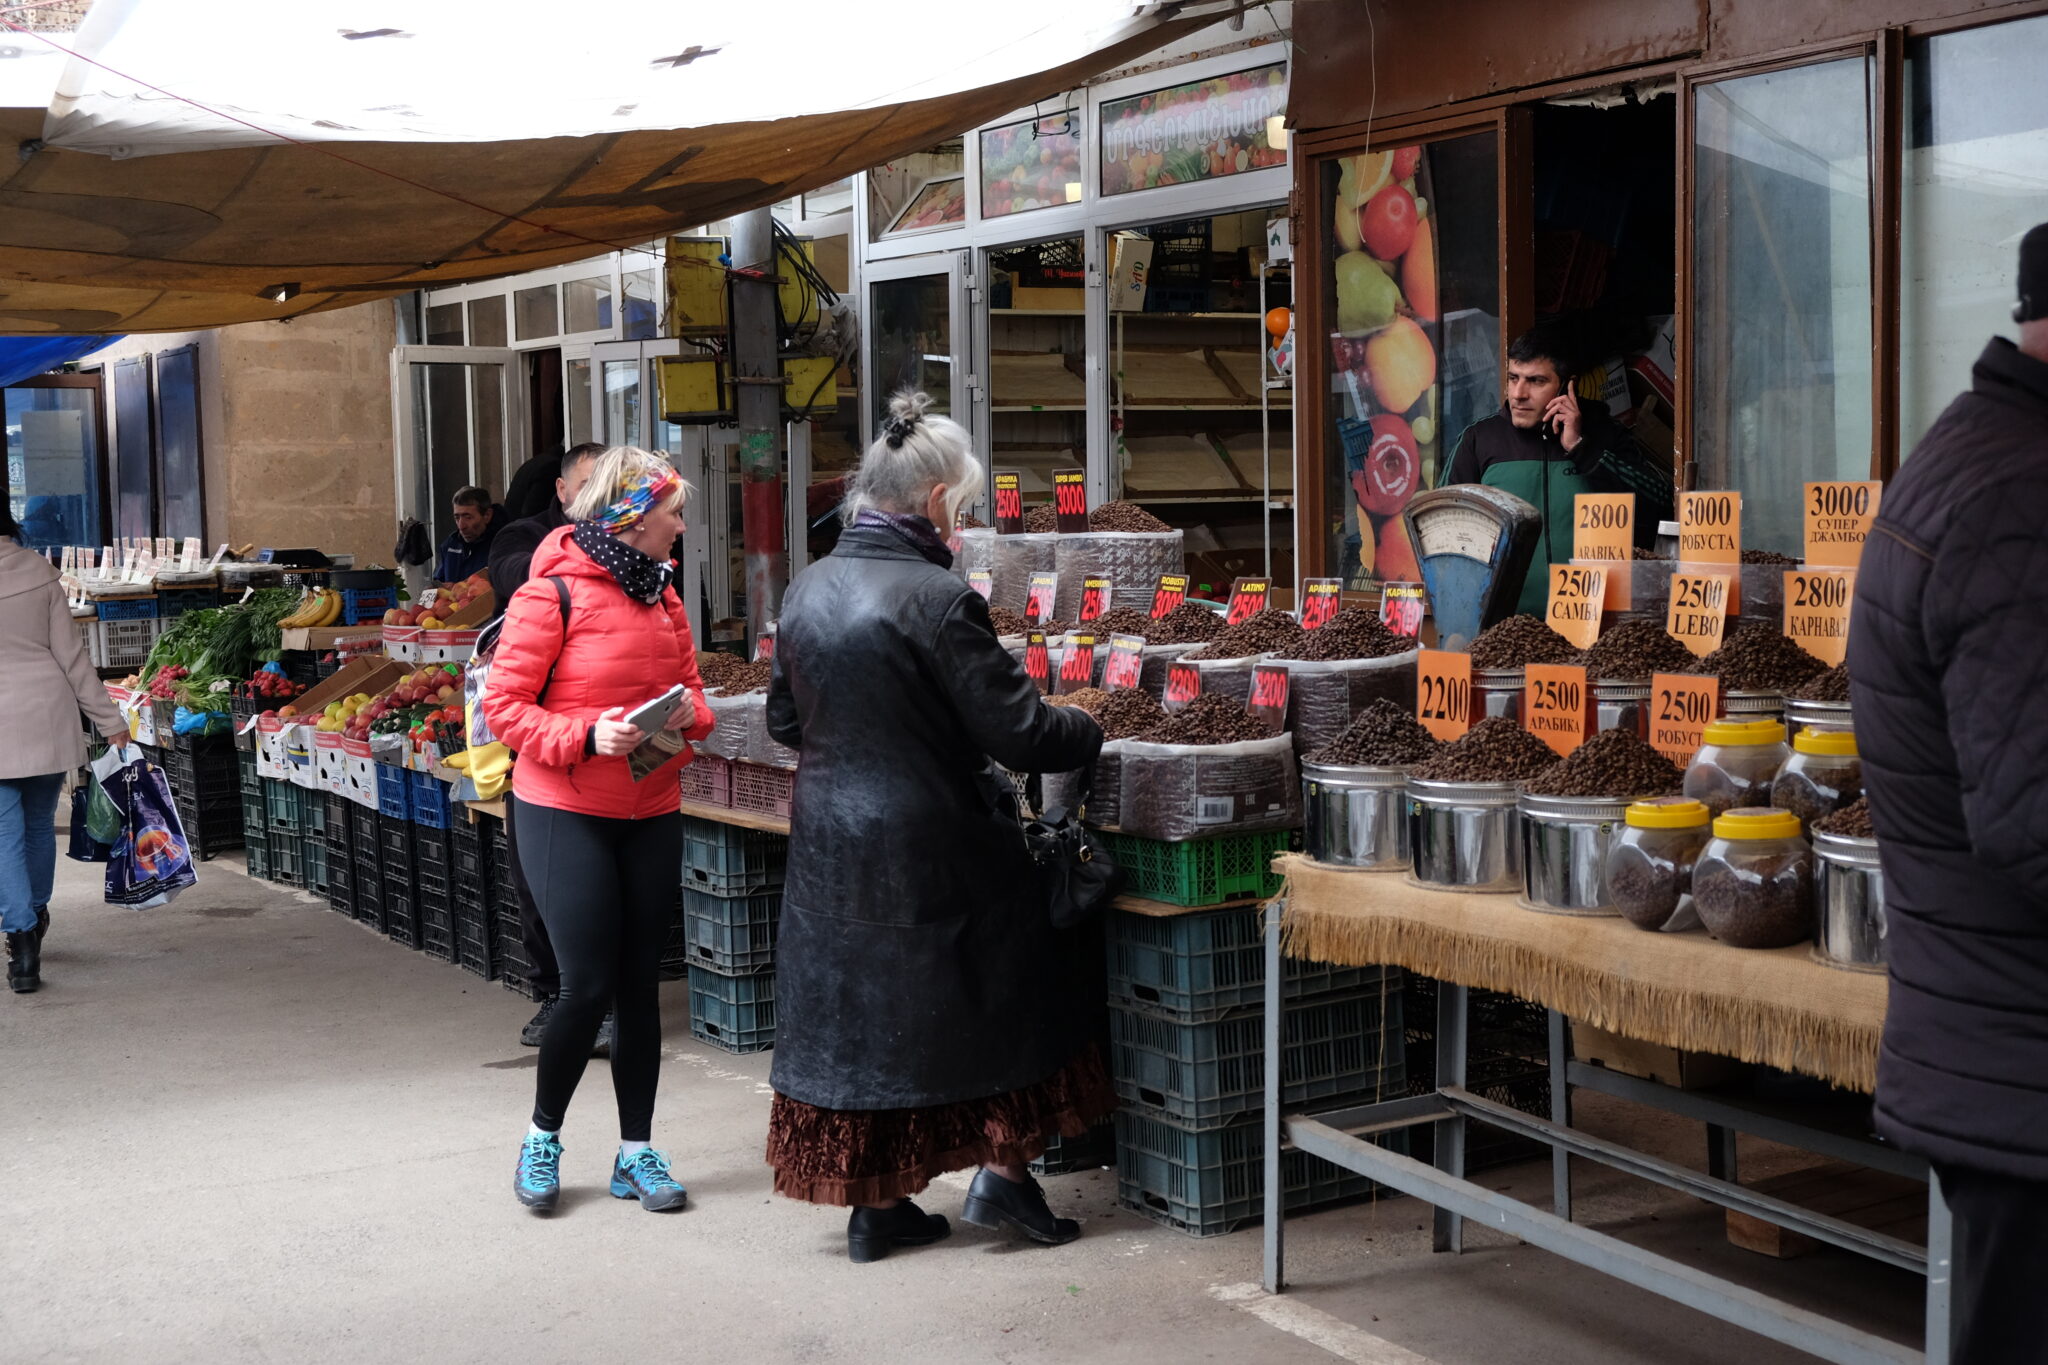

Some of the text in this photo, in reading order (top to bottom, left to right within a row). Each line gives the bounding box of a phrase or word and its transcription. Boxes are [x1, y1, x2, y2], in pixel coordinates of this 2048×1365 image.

[996, 489, 1019, 518] 2500
[1056, 484, 1085, 515] 3000
[1684, 497, 1731, 526] 3000
[1811, 486, 1869, 516] 3000
[1580, 504, 1629, 529] 2800
[1817, 519, 1858, 531] СУПЕР
[1682, 534, 1735, 551] РОБУСТА
[1810, 532, 1866, 543] ДЖАМБО
[1578, 545, 1625, 560] ARABIKA
[1161, 576, 1185, 586] ROBUSTA
[1241, 583, 1265, 592] LATINO
[1557, 569, 1601, 597] 2500
[1675, 579, 1723, 609] 2500
[1794, 577, 1846, 607] 2800
[1552, 601, 1598, 621] САМБА
[1674, 614, 1719, 637] LEBO
[1790, 616, 1847, 637] КАРНАВАЛ
[1167, 668, 1199, 702] 2200
[1251, 671, 1286, 708] 2200
[1533, 680, 1579, 712] 2500
[1422, 675, 1468, 723] 2200
[1660, 690, 1710, 724] 2500
[1529, 717, 1580, 733] АРАБИКА
[1657, 729, 1704, 747] РОБУСТ
